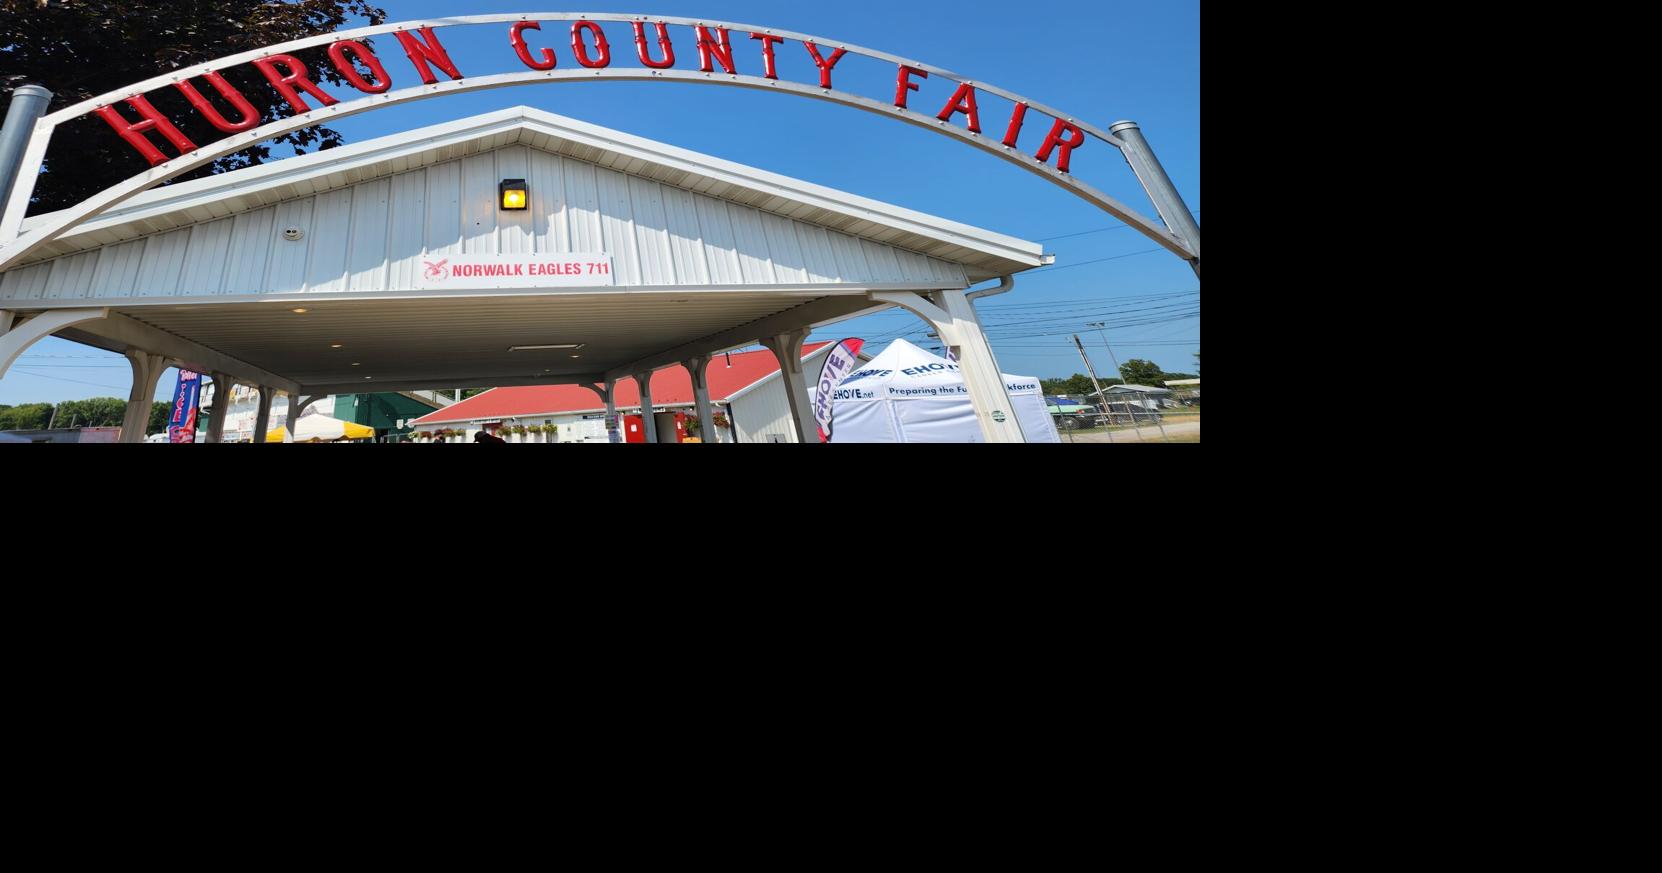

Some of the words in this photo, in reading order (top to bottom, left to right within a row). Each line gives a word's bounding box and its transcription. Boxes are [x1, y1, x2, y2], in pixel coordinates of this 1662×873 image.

[95, 25, 465, 168] HURON
[509, 20, 847, 89] COUNTY
[893, 63, 1085, 173] FAIR
[452, 263, 524, 277] NORWALK
[528, 262, 582, 276] EAGLES
[586, 261, 609, 275] 711
[889, 387, 937, 396] Preparing
[940, 386, 955, 394] the
[1007, 383, 1036, 391] kforce
